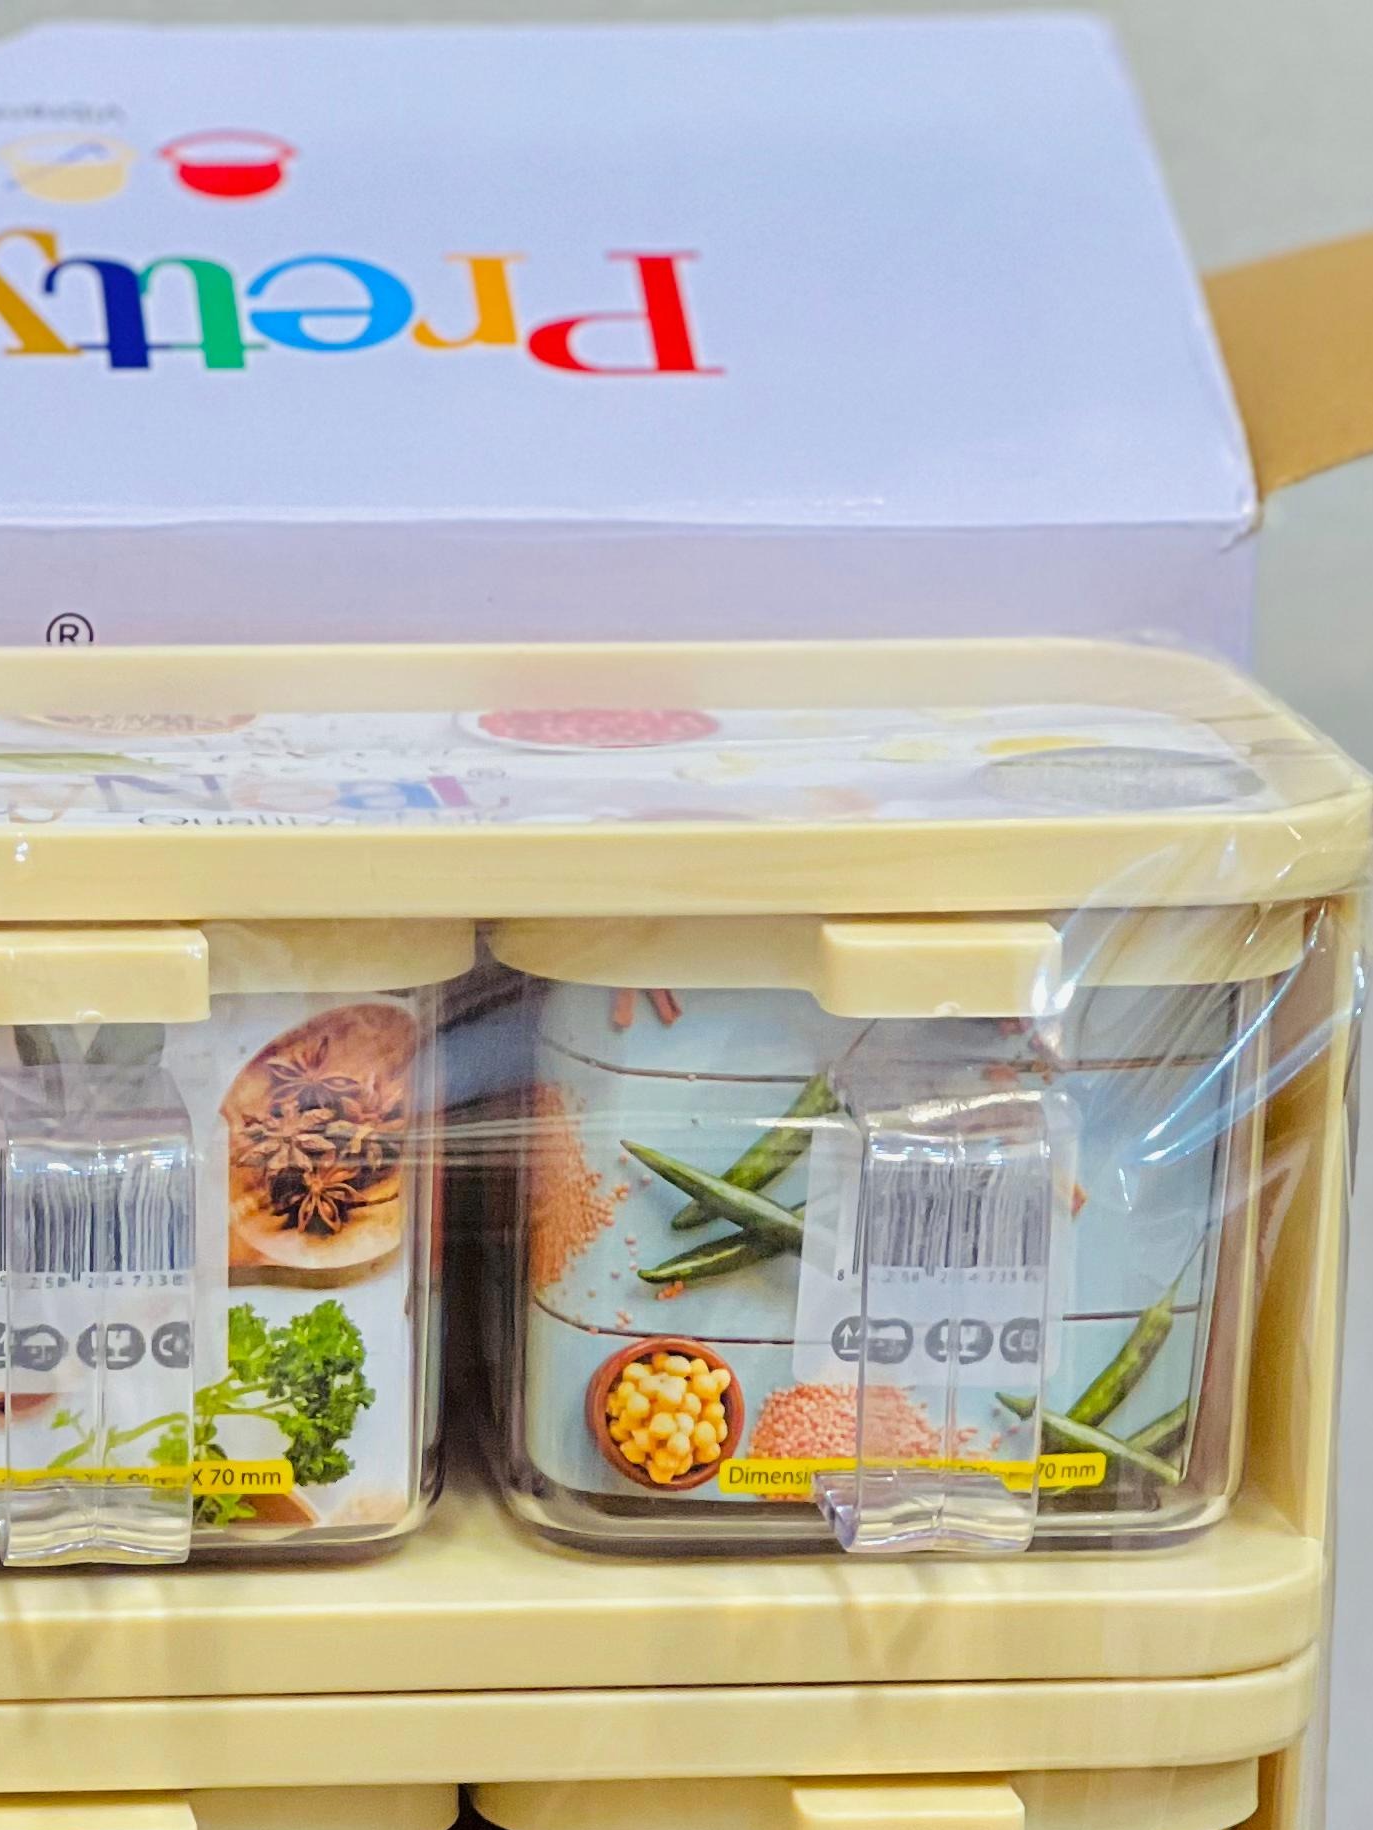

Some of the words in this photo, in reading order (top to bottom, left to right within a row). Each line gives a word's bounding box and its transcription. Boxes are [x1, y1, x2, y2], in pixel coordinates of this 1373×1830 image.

[210, 1469, 234, 1485] 70
[241, 1471, 282, 1486] mm
[729, 1467, 813, 1485] Dimensi
[1061, 1463, 1097, 1478] mm
